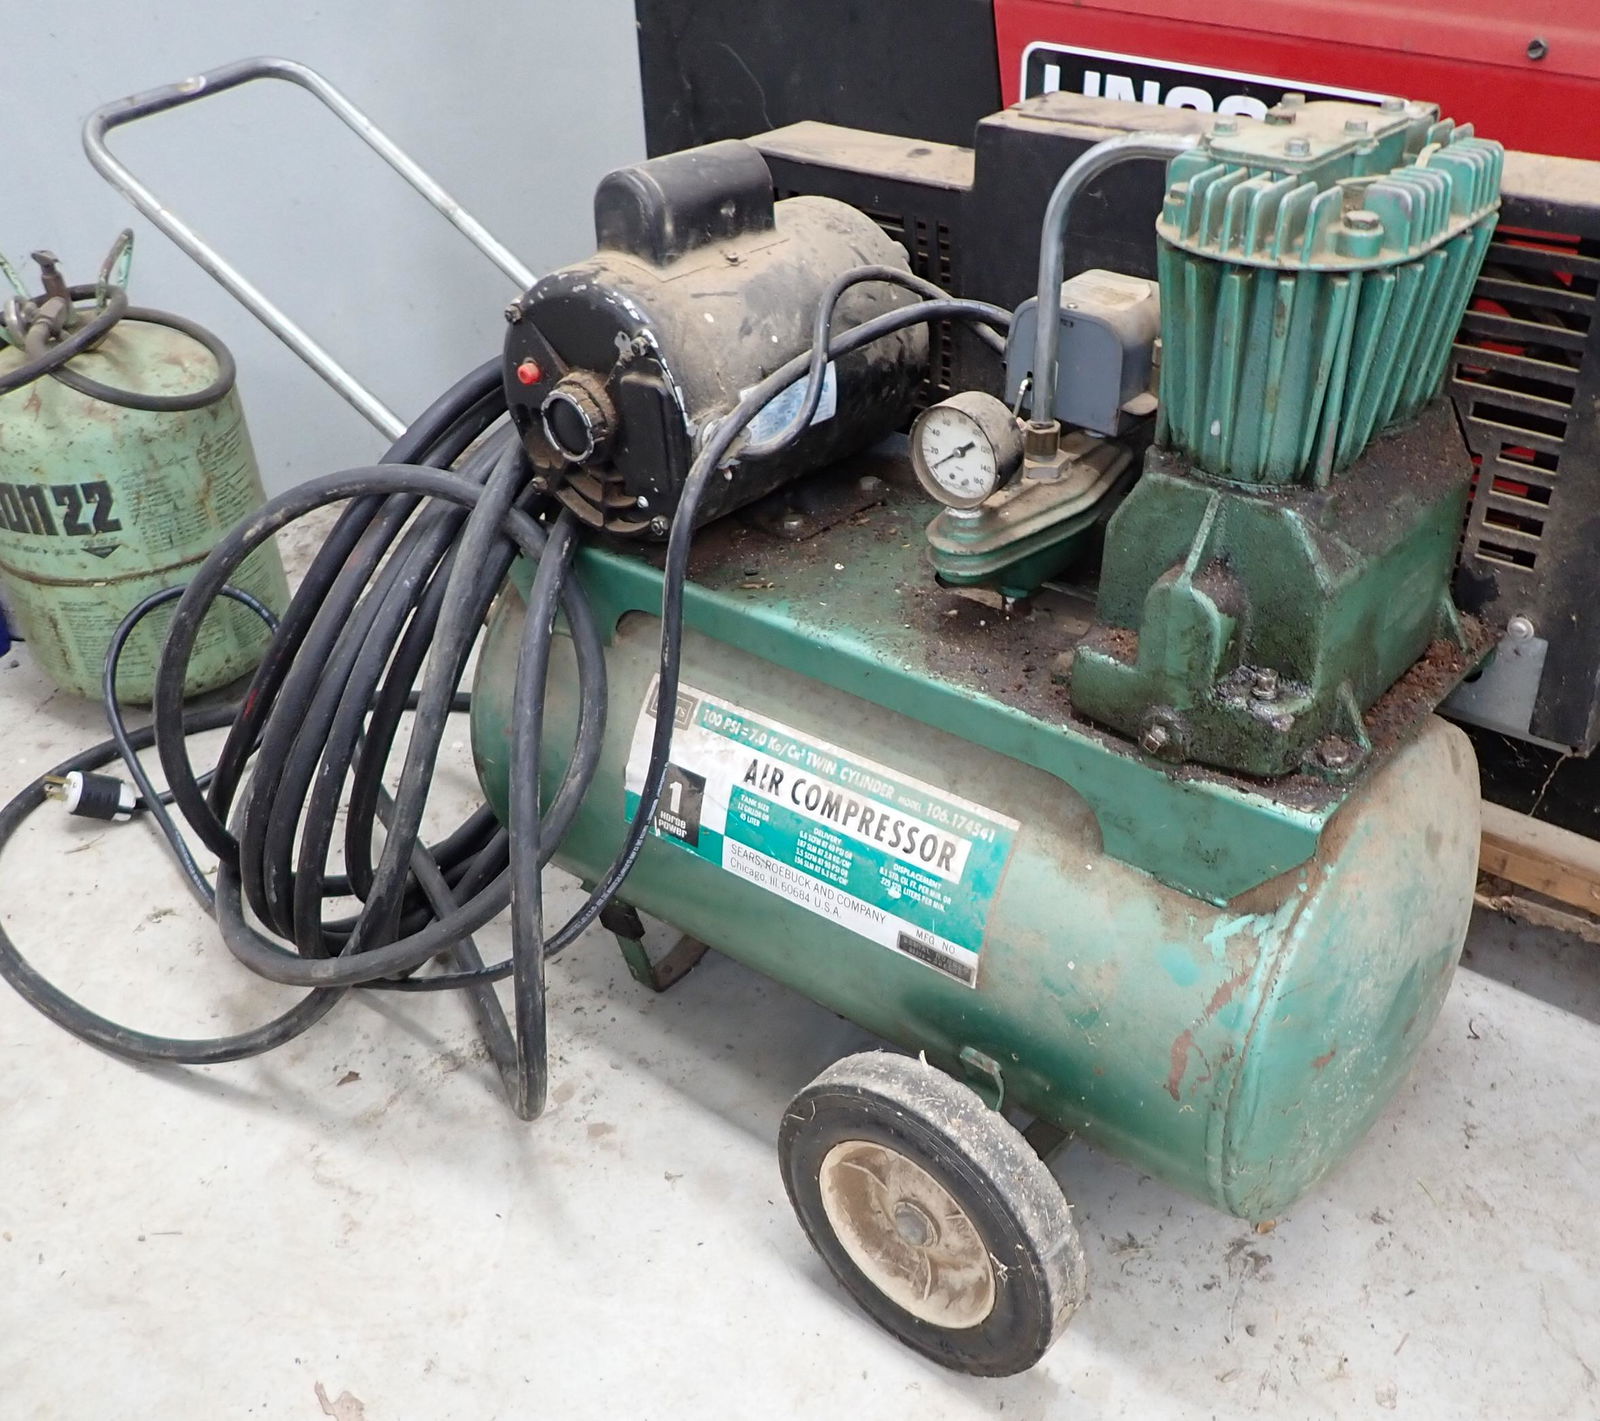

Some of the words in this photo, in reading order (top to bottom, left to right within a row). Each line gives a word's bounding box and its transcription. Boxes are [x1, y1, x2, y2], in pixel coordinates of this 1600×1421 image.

[703, 709, 723, 727] 100
[724, 718, 742, 736] PSI
[805, 751, 837, 776] TWIN
[840, 767, 895, 800] CYLINDER
[926, 803, 996, 843] 106.174541
[669, 781, 683, 814] 1
[743, 759, 784, 797] AIR
[791, 778, 957, 872] COMPRESSOR
[814, 827, 842, 845] DELIVERY
[730, 857, 767, 885] Chicago,
[781, 882, 811, 903] 60684
[814, 895, 842, 919] U.S.A.
[765, 861, 811, 890] ROEBUCK
[812, 882, 834, 900] AND
[837, 893, 886, 924] COMPANY
[893, 863, 942, 890] DISPLACEMENT
[918, 884, 930, 895] PER
[903, 887, 921, 901] LITERS
[921, 895, 933, 907] PER
